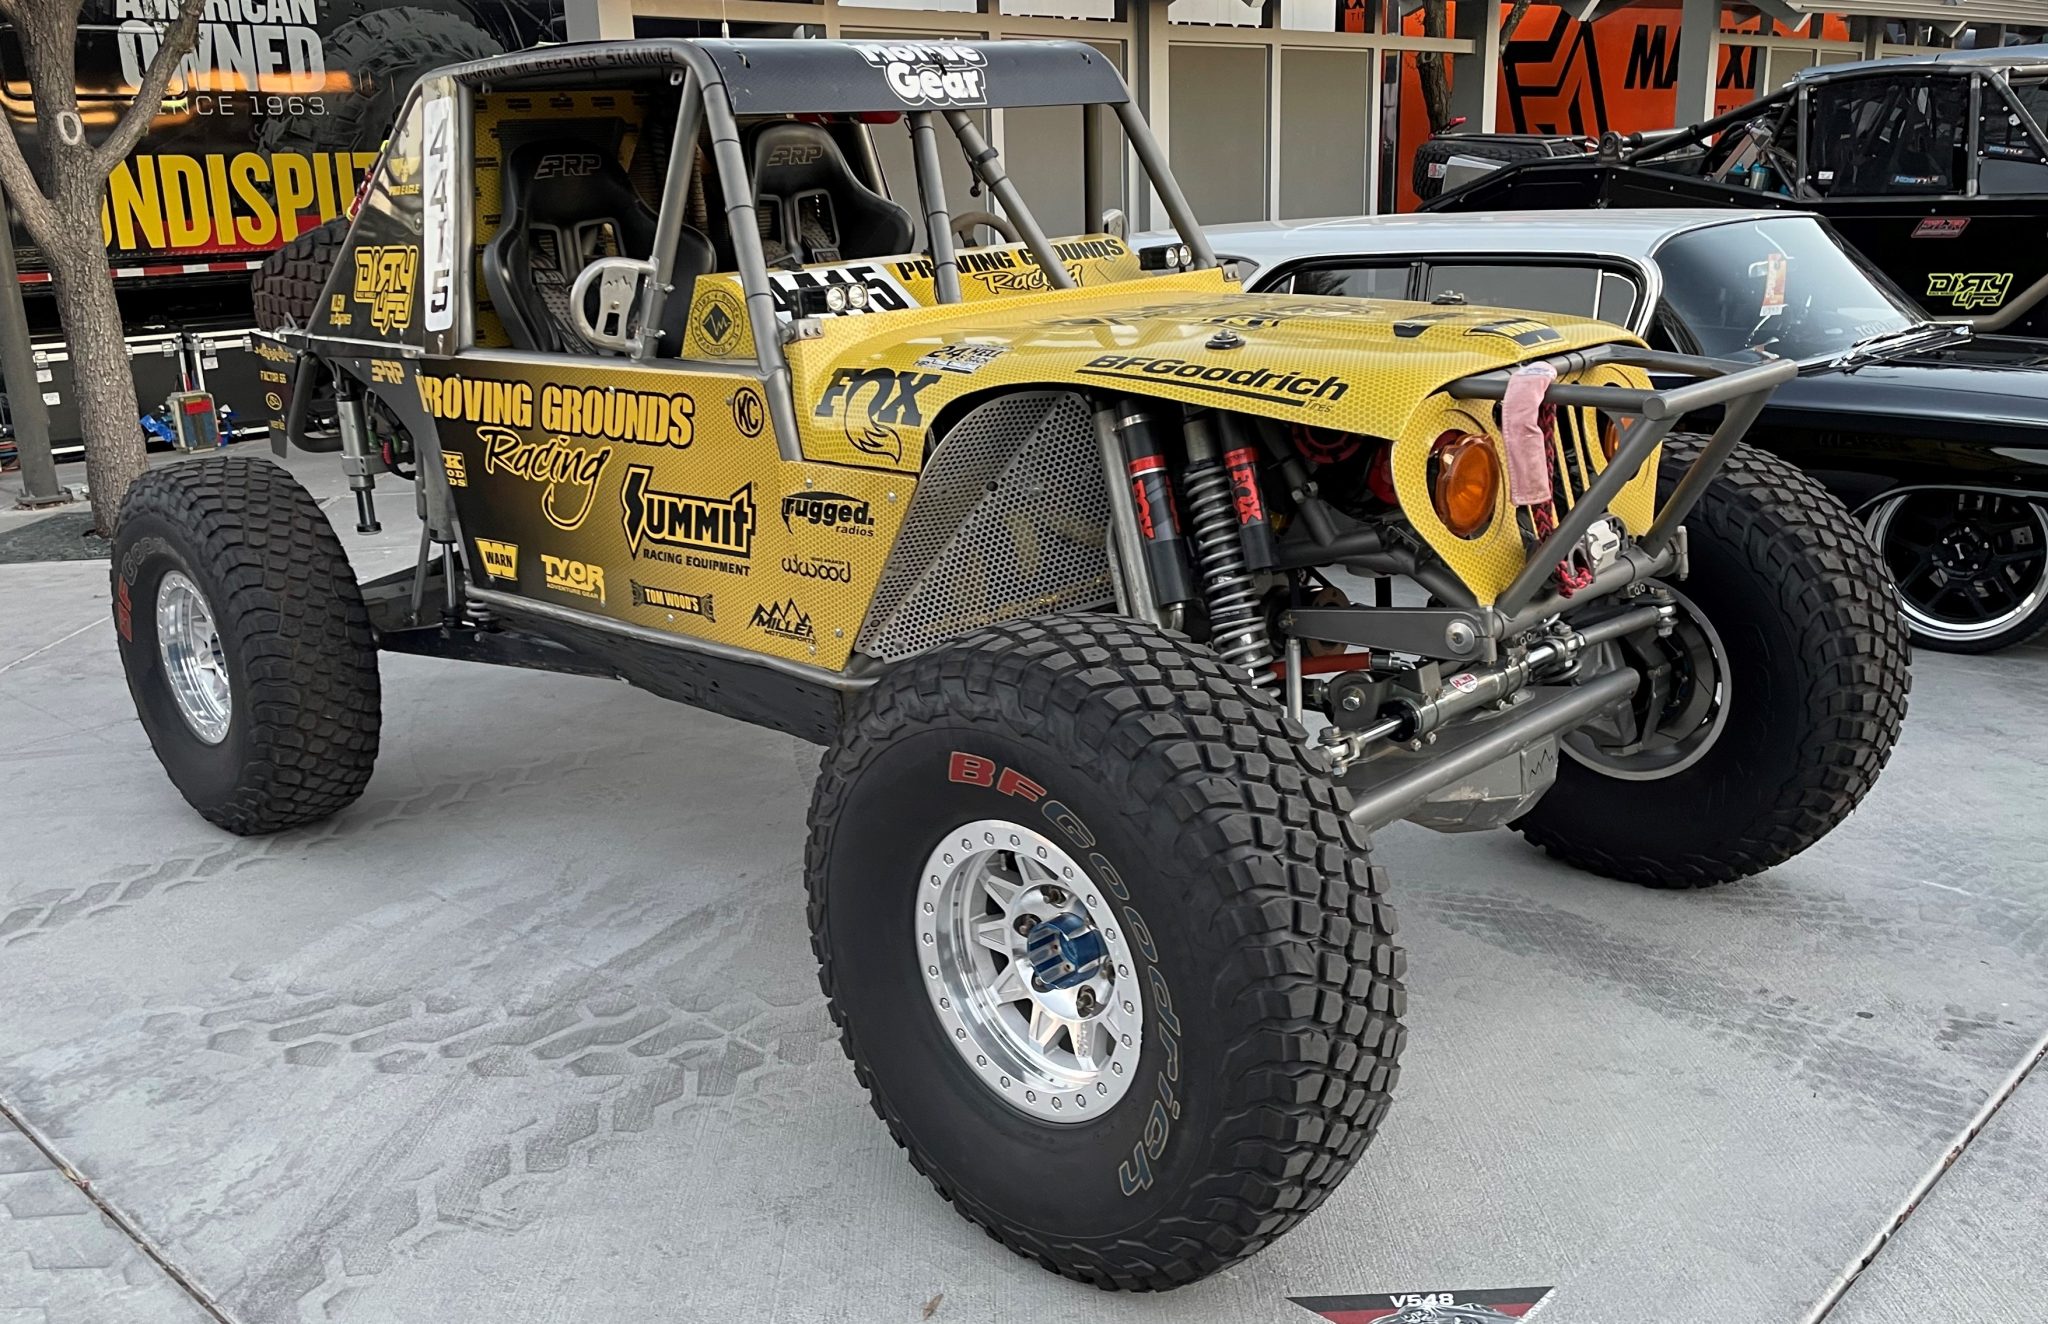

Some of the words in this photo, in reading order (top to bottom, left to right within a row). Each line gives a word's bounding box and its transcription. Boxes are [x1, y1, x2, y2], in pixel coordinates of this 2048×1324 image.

[887, 61, 980, 99] Gear
[251, 96, 330, 116] 1963.
[896, 250, 1015, 281] PRVING
[1017, 238, 1124, 265] GOUNDS
[1929, 273, 2014, 296] DIRTY
[1084, 355, 1349, 401] BFGoodrich
[815, 367, 942, 427] FOX
[541, 386, 694, 449] GROUNDS
[736, 397, 760, 432] KC
[476, 425, 612, 531] Racing
[835, 526, 874, 537] radios
[484, 551, 513, 568] WARN
[643, 549, 683, 565] RACING
[685, 556, 751, 577] EQUIPMENT
[582, 590, 599, 599] GEAR
[644, 588, 664, 606] TOM
[664, 591, 700, 612] WOOD'S
[948, 751, 1182, 1198] BFGoodrich
[1389, 1293, 1454, 1308] V548
